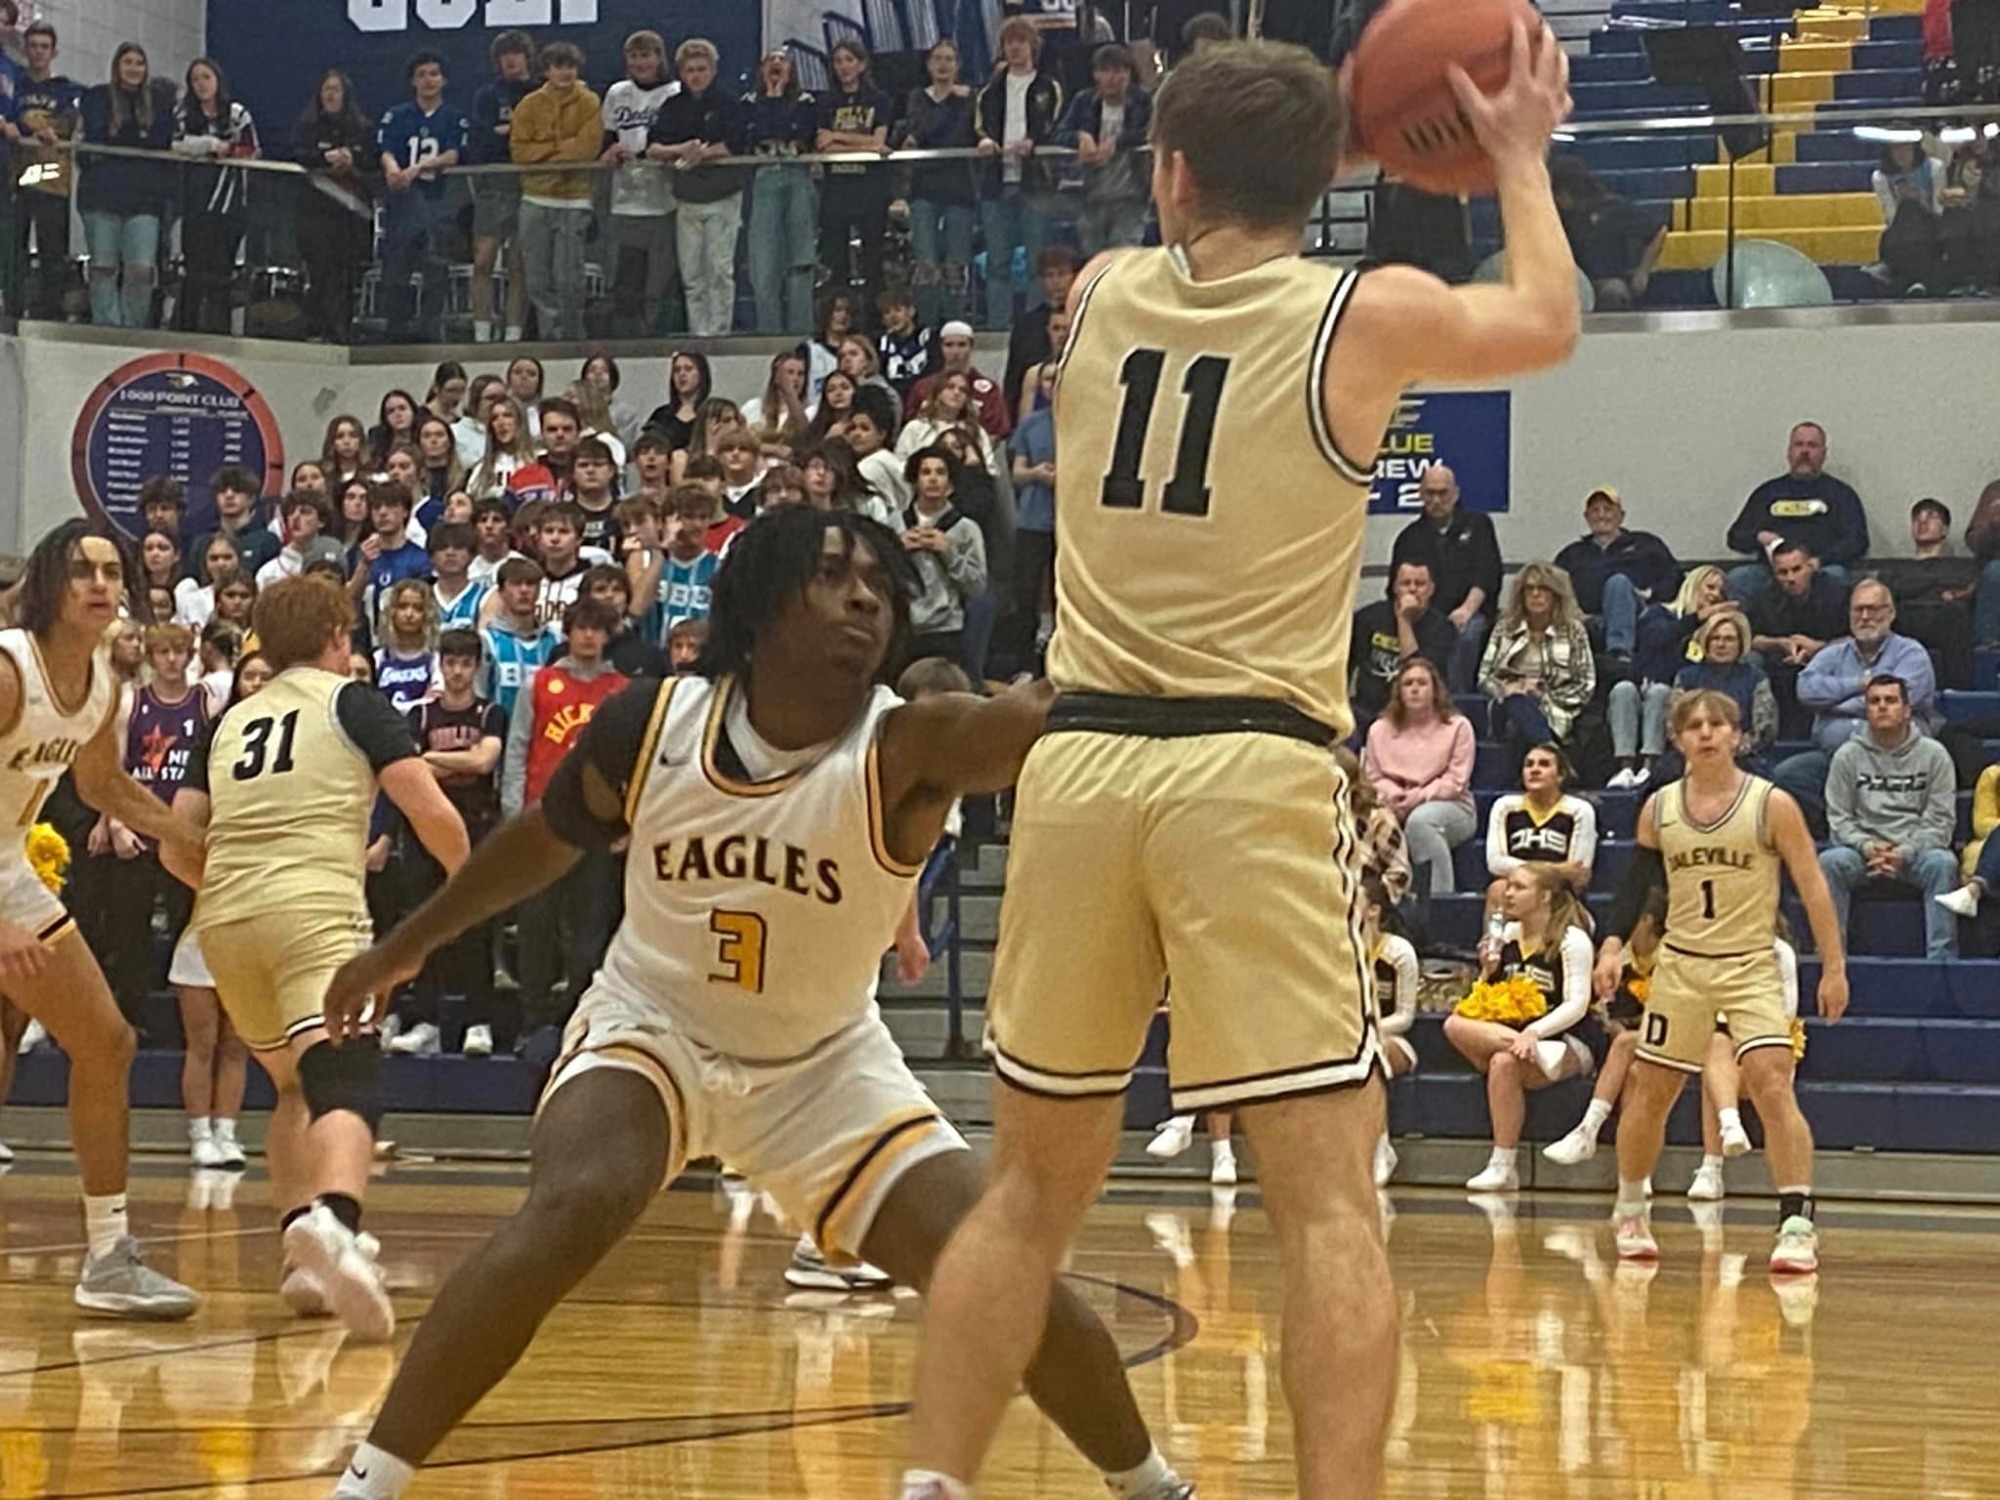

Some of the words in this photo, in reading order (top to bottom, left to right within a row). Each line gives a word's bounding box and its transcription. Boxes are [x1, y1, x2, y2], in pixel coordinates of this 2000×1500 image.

[407, 135, 439, 180] 12
[120, 390, 155, 402] 1000
[156, 391, 199, 406] POINT
[202, 394, 240, 408] CLUB
[1101, 346, 1232, 517] 11
[183, 719, 194, 737] 1
[231, 708, 301, 782] 31
[652, 834, 844, 905] EAGLES
[1701, 878, 1716, 920] 1
[707, 907, 768, 995] 3
[1645, 1011, 1669, 1047] D
